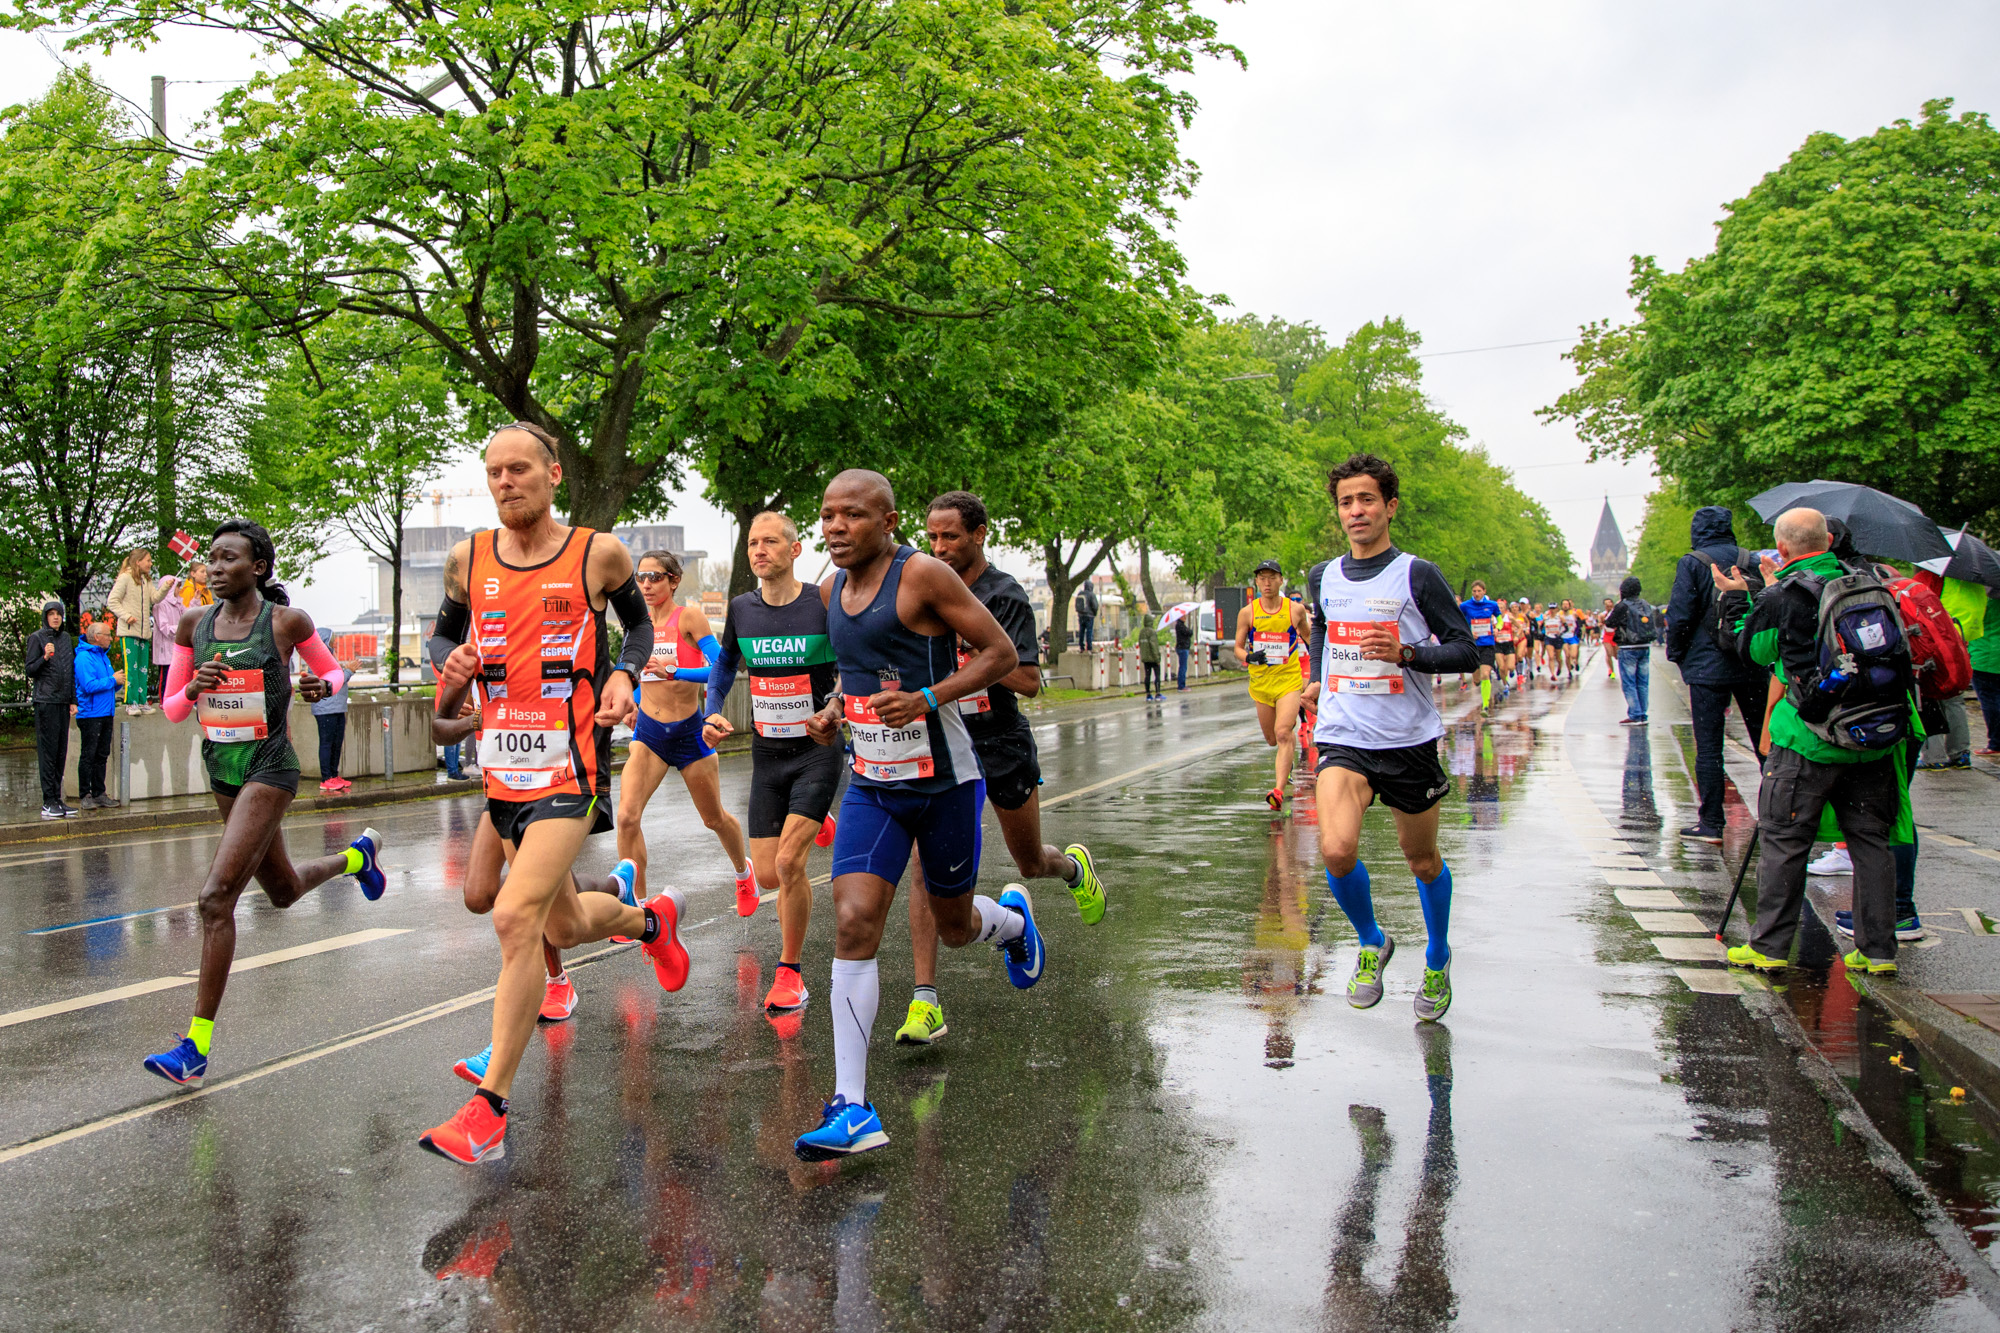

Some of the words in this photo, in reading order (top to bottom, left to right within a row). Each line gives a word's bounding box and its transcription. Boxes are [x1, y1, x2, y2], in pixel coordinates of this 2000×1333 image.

[1349, 627, 1363, 637] Has
[752, 638, 806, 654] VEGAN
[752, 656, 794, 666] RUNNERS
[796, 656, 805, 664] IK
[880, 672, 899, 681] 2011
[217, 676, 245, 688] aspa
[768, 682, 795, 692] Haspa
[1349, 681, 1370, 689] Mobil
[208, 697, 243, 710] Masai
[754, 699, 809, 711] Johansson
[980, 700, 987, 708] A
[509, 708, 546, 723] Haspa
[215, 729, 236, 737] Mobil
[851, 725, 878, 743] Peter
[881, 728, 922, 743] Fane
[494, 732, 547, 752] 1004
[877, 748, 887, 756] 73
[872, 765, 897, 775] Mobil
[504, 773, 532, 782] Mobil
